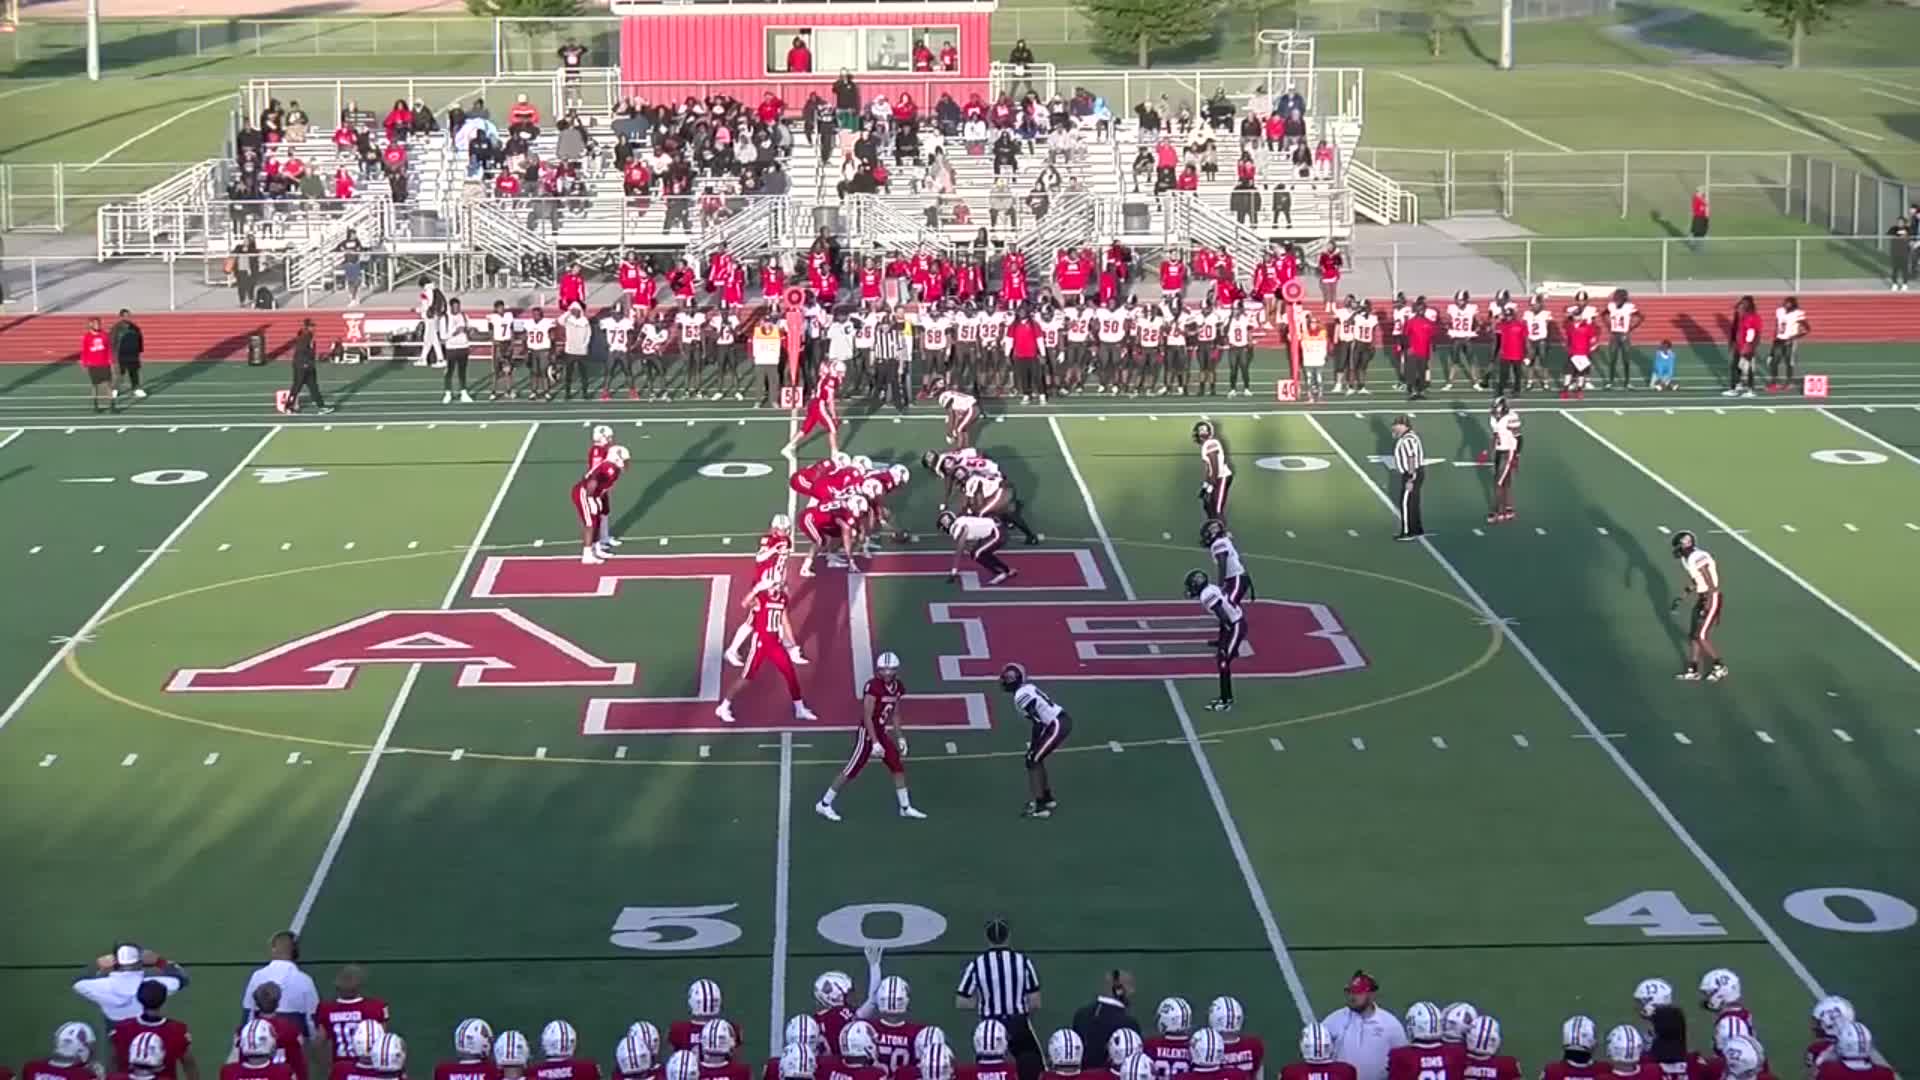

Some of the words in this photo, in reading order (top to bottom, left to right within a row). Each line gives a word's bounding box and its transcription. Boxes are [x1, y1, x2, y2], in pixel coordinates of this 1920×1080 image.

[981, 324, 998, 338] 32
[1531, 322, 1540, 335] 2
[609, 329, 625, 344] 73
